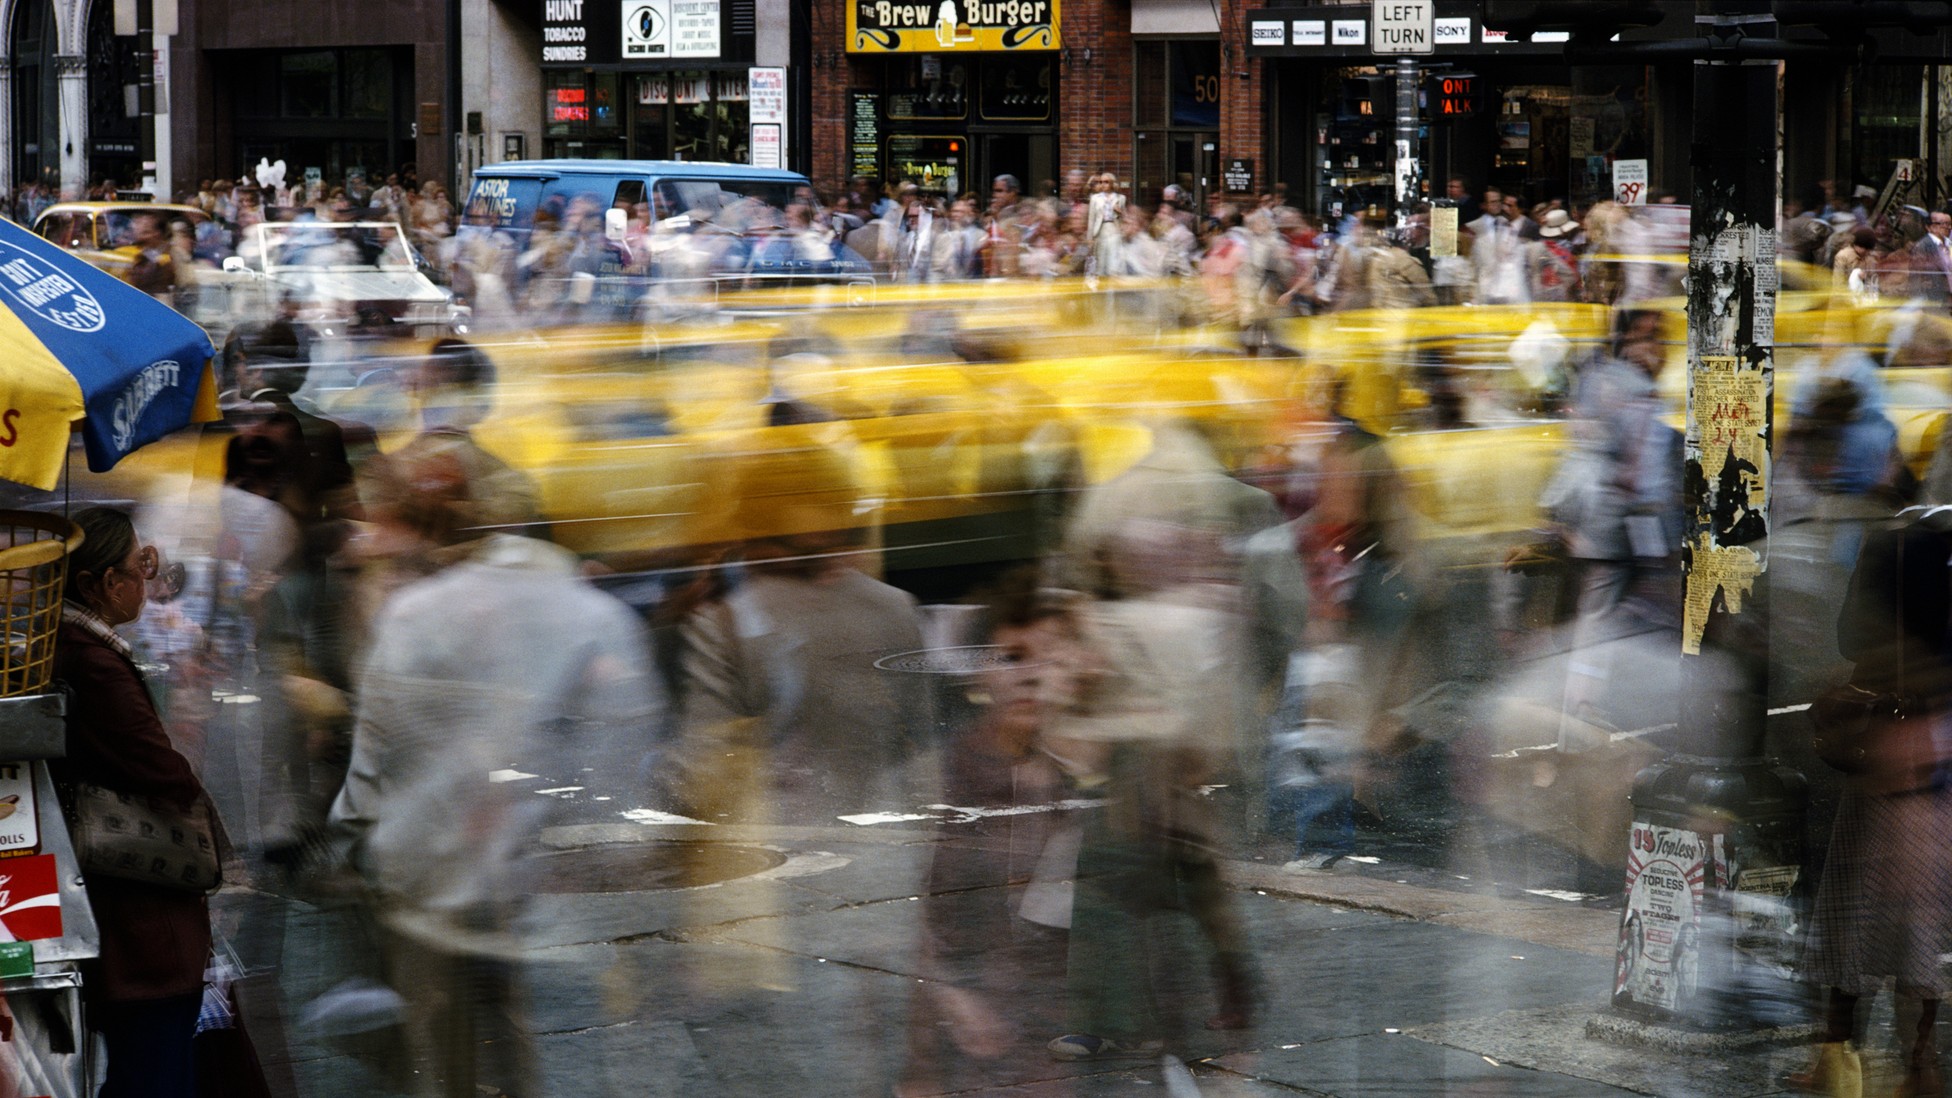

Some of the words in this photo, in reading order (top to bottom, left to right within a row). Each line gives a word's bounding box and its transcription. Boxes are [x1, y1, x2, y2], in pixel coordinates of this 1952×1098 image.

[546, 0, 583, 21] HUNT
[862, 5, 875, 18] THE
[876, 1, 931, 26] Brew
[964, 0, 1046, 26] Burger
[1383, 6, 1423, 21] LEFT
[544, 26, 586, 42] TOBACCO
[1252, 28, 1283, 39] SEIKO
[1338, 28, 1359, 37] Nikon
[1381, 29, 1424, 43] TURN
[1436, 26, 1468, 36] SONY
[543, 46, 587, 61] SUNDRIES
[642, 81, 697, 99] DISCUNT
[1443, 79, 1471, 94] ONT
[1441, 99, 1471, 113] ALK
[475, 179, 509, 197] ASTOR
[17, 273, 75, 307] INSPECTED
[0, 833, 25, 846] OLLS
[1656, 831, 1696, 861] Topless
[1641, 874, 1684, 892] TOPLESS
[1650, 903, 1673, 913] TWO
